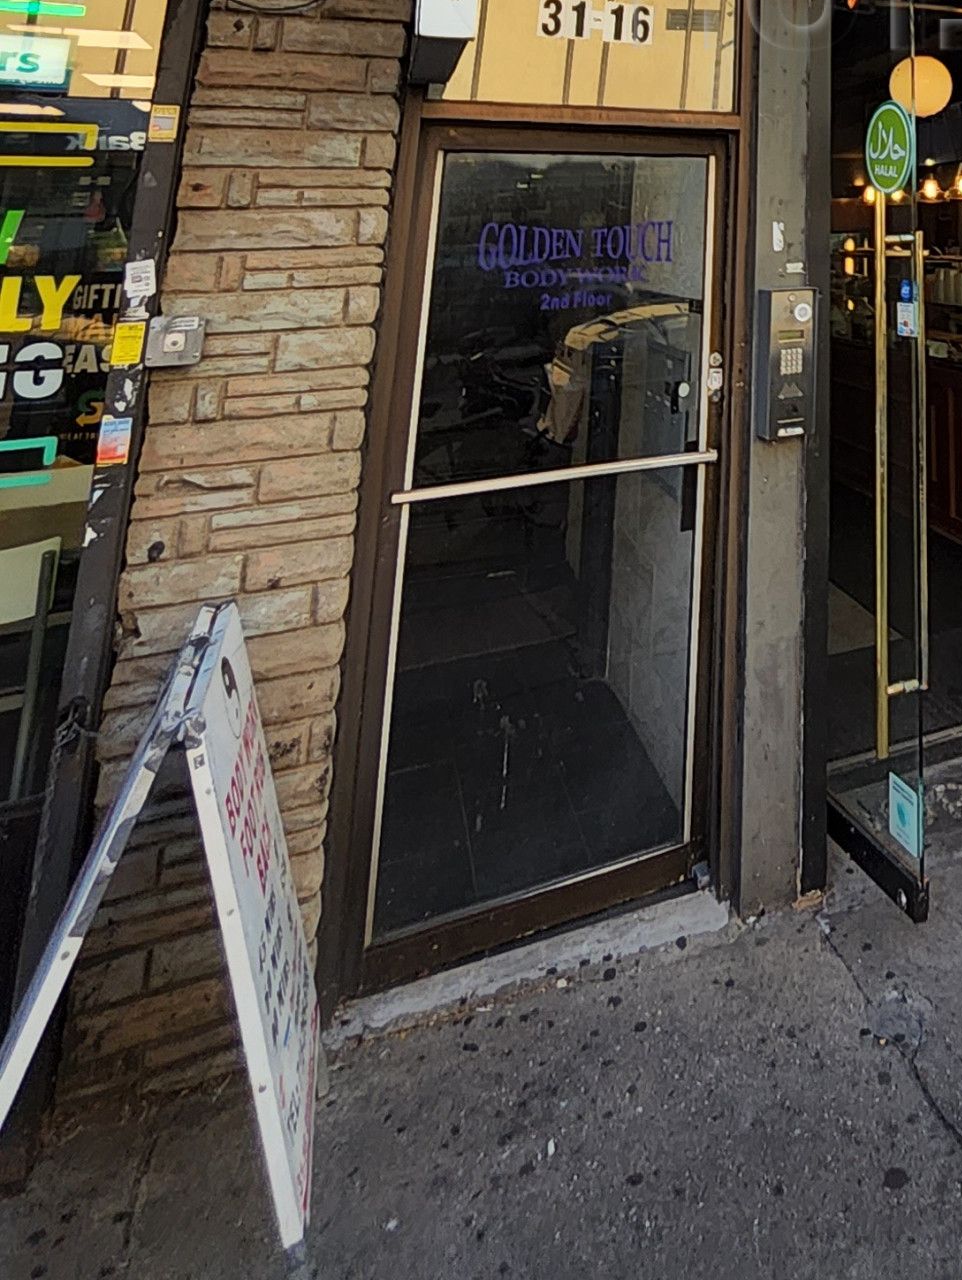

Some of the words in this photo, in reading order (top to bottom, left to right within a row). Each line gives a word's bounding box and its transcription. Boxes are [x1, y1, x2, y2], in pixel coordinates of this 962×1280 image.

[869, 120, 907, 161] حلال
[874, 163, 899, 178] HALAL
[478, 222, 584, 271] GOLDEN
[591, 220, 674, 263] TOUCH
[504, 270, 569, 289] BODY
[0, 274, 82, 333] LY
[72, 282, 122, 310] GIFTI
[540, 292, 570, 311] 2nd
[574, 290, 614, 308] Floor
